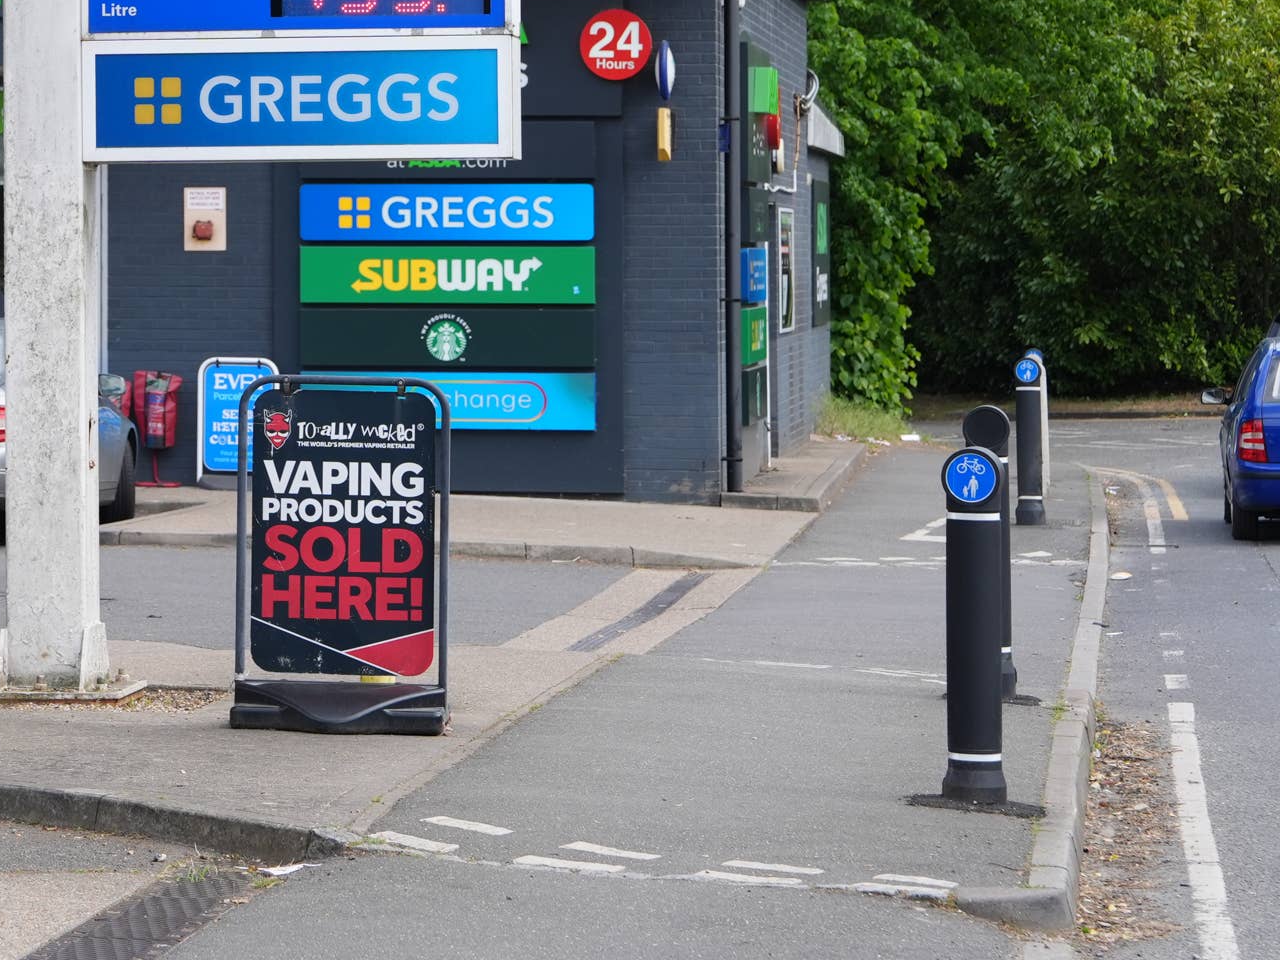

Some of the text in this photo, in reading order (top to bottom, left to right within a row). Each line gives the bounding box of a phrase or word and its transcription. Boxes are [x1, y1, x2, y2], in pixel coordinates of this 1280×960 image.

[101, 3, 137, 17] Litre
[589, 21, 643, 58] 24
[596, 59, 635, 70] Hours
[199, 72, 460, 123] GREGGS
[381, 196, 554, 229] GREGGS
[351, 257, 543, 293] SUBWAY
[264, 460, 424, 497] VAPING
[263, 497, 424, 525] PRODUCTS
[262, 525, 424, 573] SOLD
[261, 574, 424, 621] HERE!
